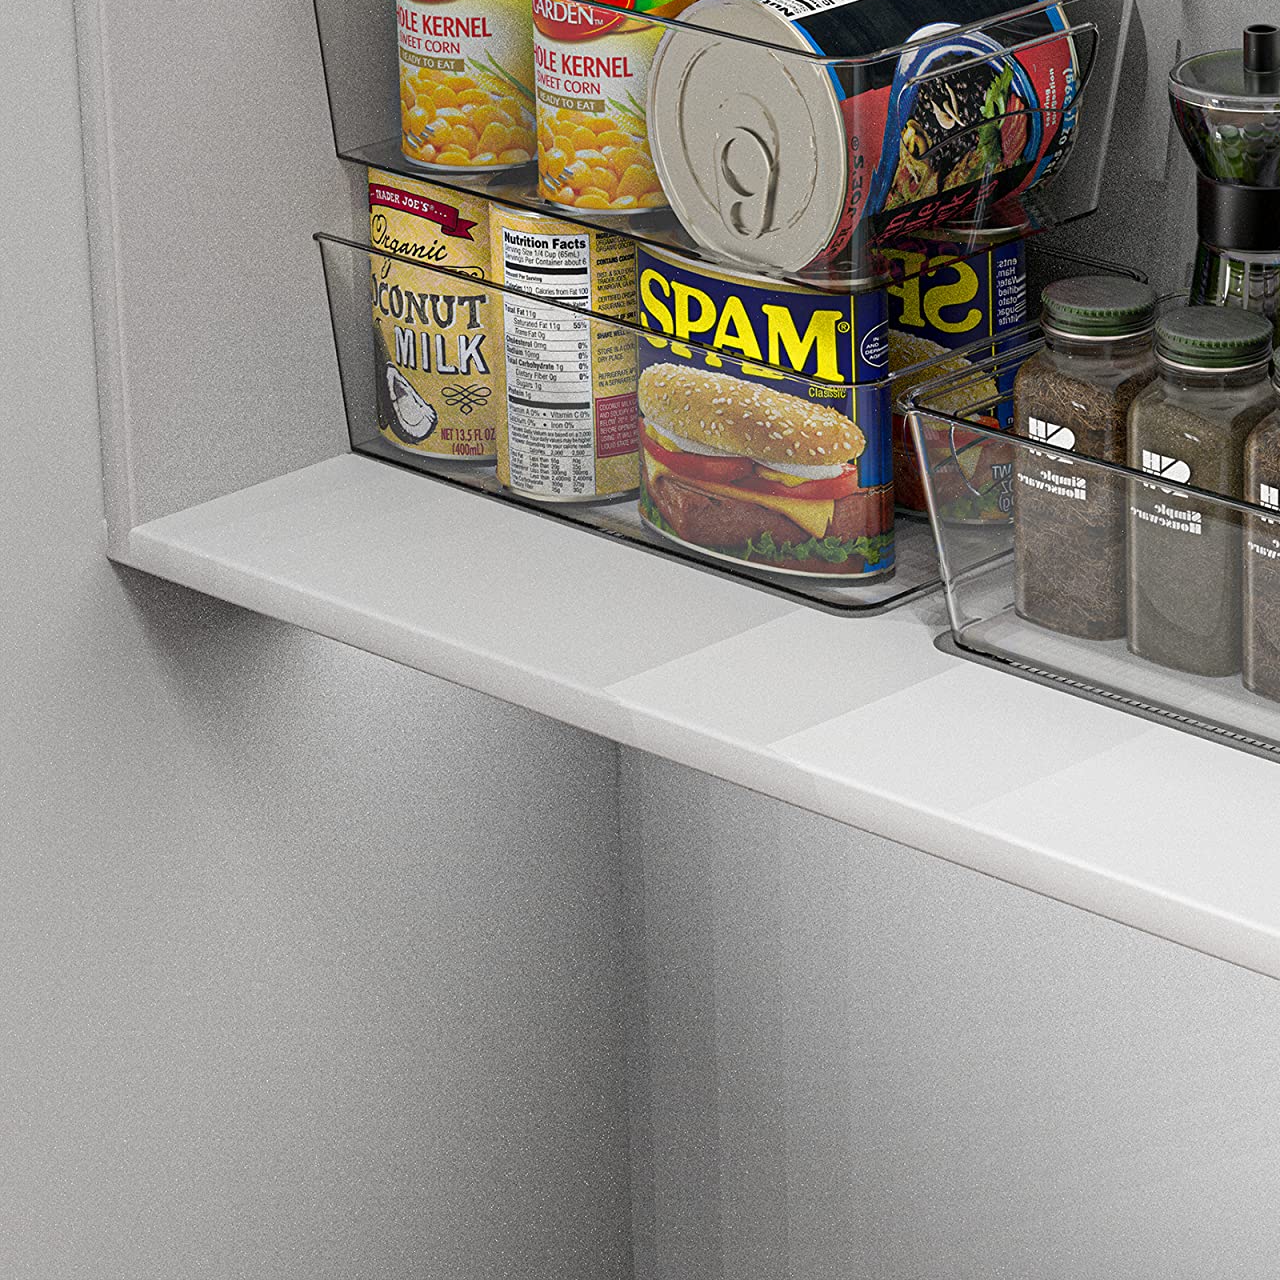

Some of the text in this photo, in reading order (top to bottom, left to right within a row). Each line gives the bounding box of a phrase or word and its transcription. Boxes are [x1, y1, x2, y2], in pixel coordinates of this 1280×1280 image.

[422, 13, 493, 38] KERNEL
[424, 38, 462, 56] CORN
[422, 57, 455, 71] TO EAT
[561, 53, 634, 79] KERNEL
[563, 78, 602, 96] CORN
[562, 98, 597, 111] TO EAT
[846, 154, 865, 219] JOE'S
[375, 188, 430, 213] TRADER JOE'S
[371, 214, 448, 262] Organic
[504, 231, 549, 250] Nutrition
[552, 238, 587, 250] Facts
[535, 257, 581, 266] Container about
[545, 250, 580, 259] Cup (65mL)
[535, 288, 555, 296] Calories
[640, 268, 847, 383] SPAM
[393, 323, 492, 376] MILK
[441, 427, 453, 441] NET
[454, 428, 473, 442] 13.5
[473, 428, 484, 442] FL
[485, 428, 497, 442] OZ
[452, 441, 484, 456] (400mL)
